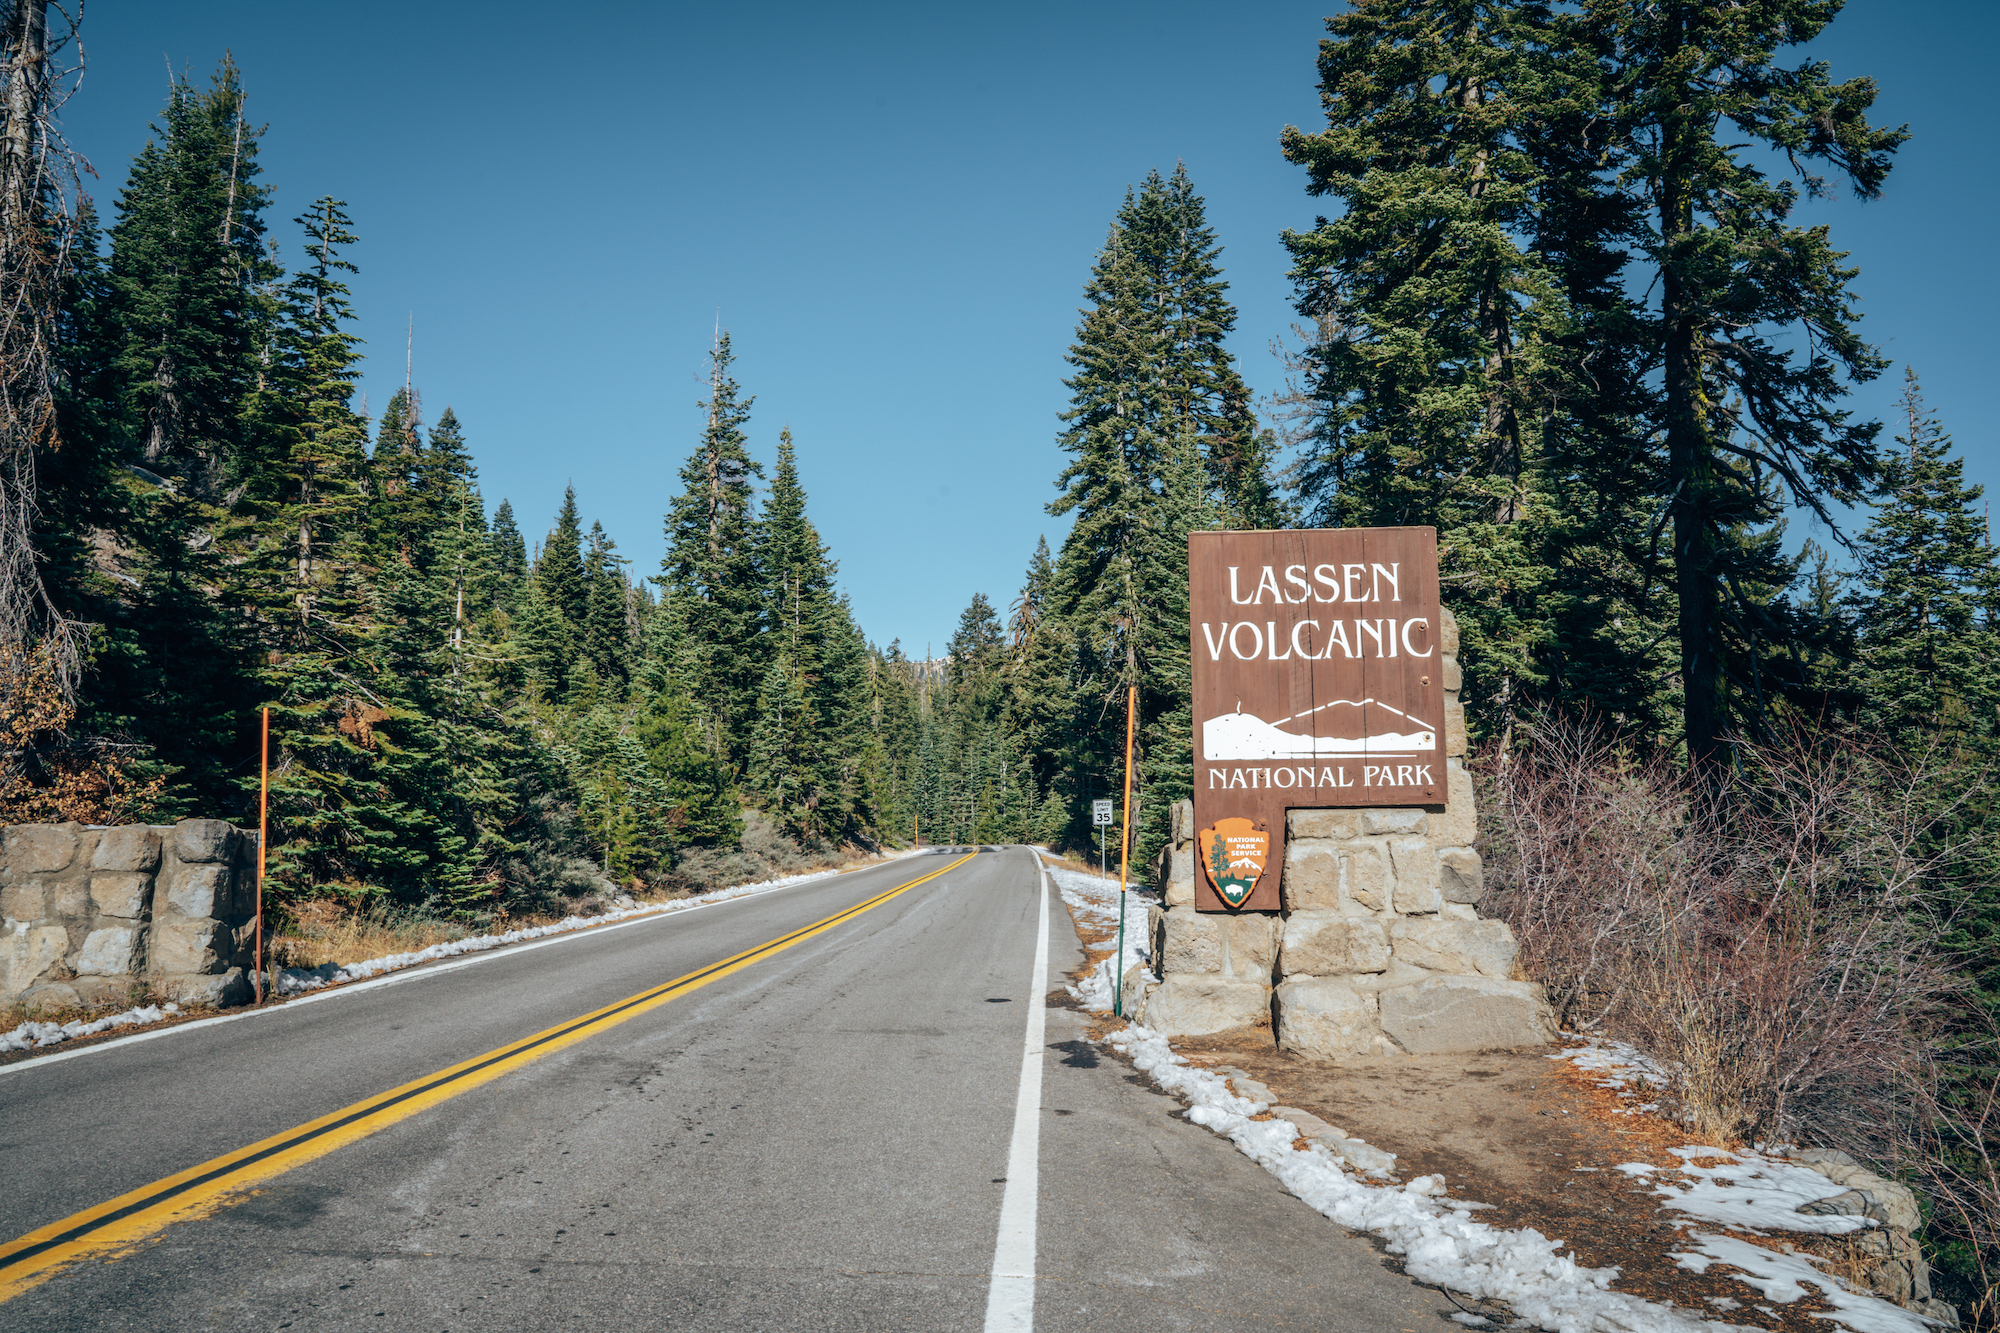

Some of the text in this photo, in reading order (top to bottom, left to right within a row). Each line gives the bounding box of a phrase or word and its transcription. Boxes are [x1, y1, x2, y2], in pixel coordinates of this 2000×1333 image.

[1228, 562, 1401, 605] LASSEN
[1201, 617, 1433, 661] VOLCANIC
[1208, 764, 1434, 790] NATIONAL PARK
[1096, 813, 1110, 822] 35
